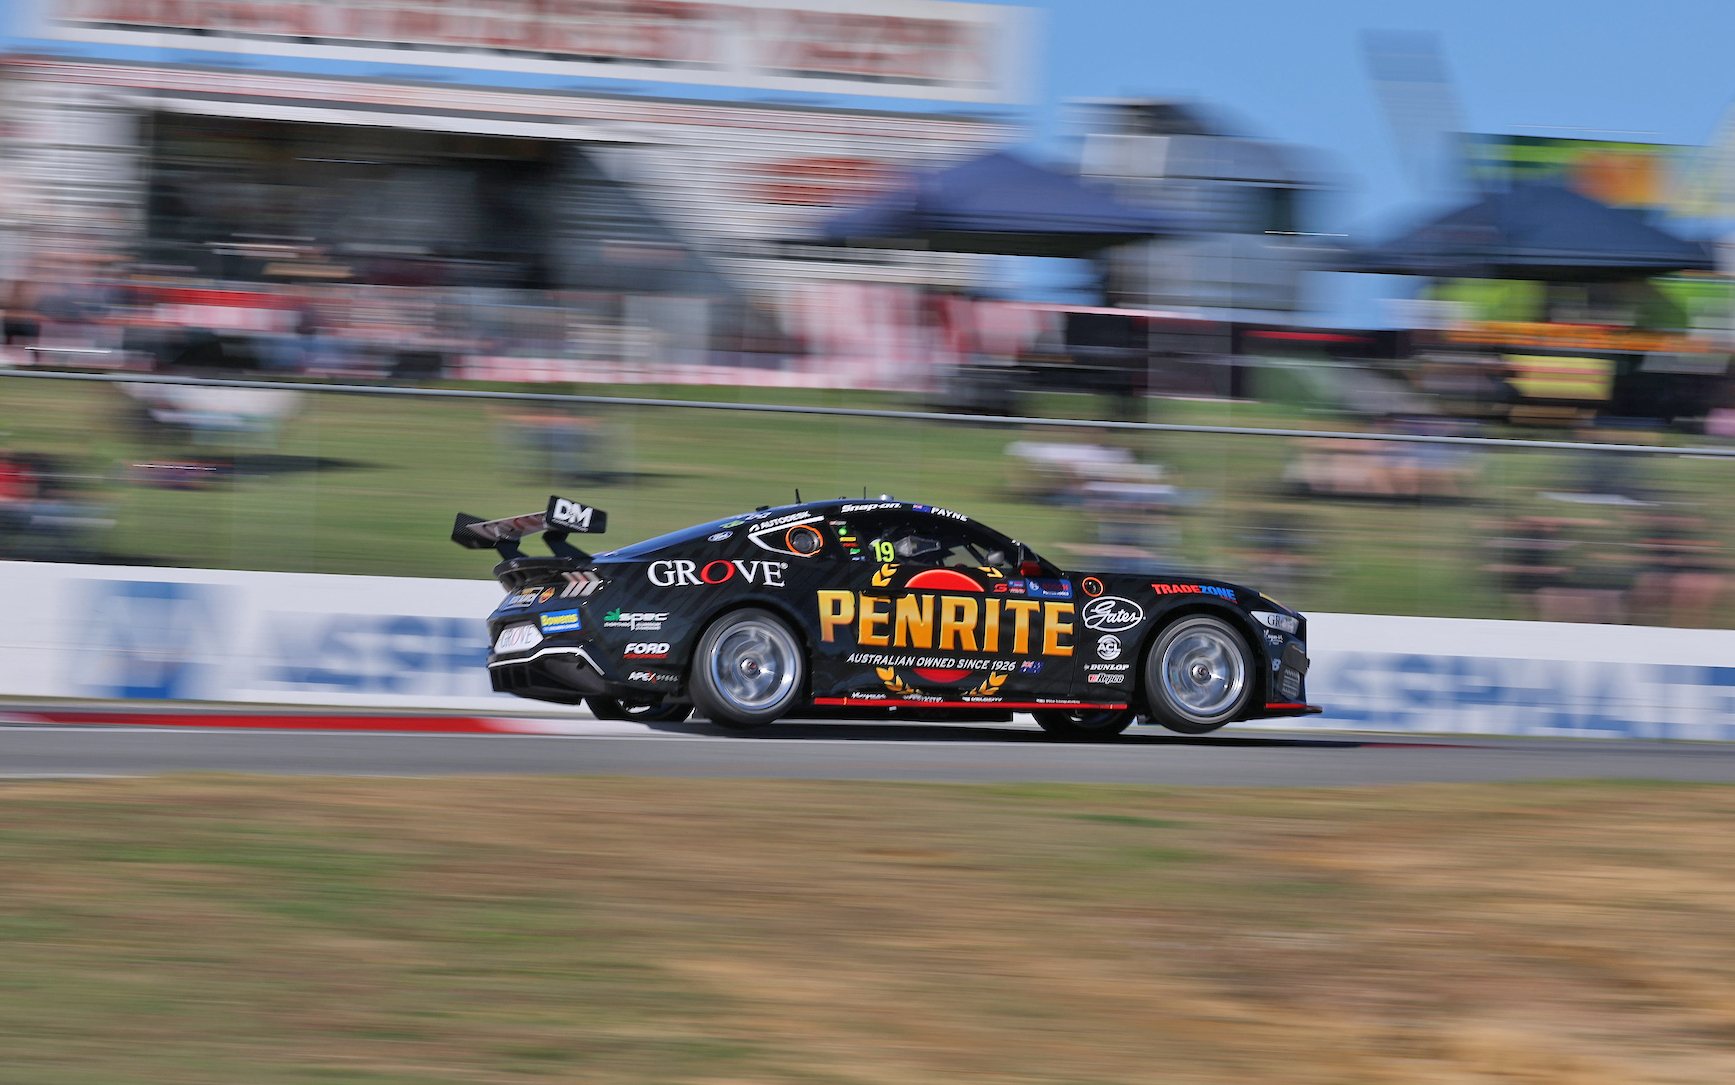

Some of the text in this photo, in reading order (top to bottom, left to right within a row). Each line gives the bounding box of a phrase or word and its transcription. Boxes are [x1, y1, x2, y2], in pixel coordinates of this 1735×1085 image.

[760, 511, 812, 529] AUTODESK
[930, 506, 969, 522] PAYNE
[872, 541, 895, 563] 19
[817, 590, 1076, 657] PENRITE
[1086, 600, 1141, 629] Gates
[500, 623, 536, 649] GROVE
[623, 642, 671, 655] FORD
[1098, 642, 1121, 654] ACL
[847, 652, 1016, 672] AUSTRALIAN OWNED SINCE 1926
